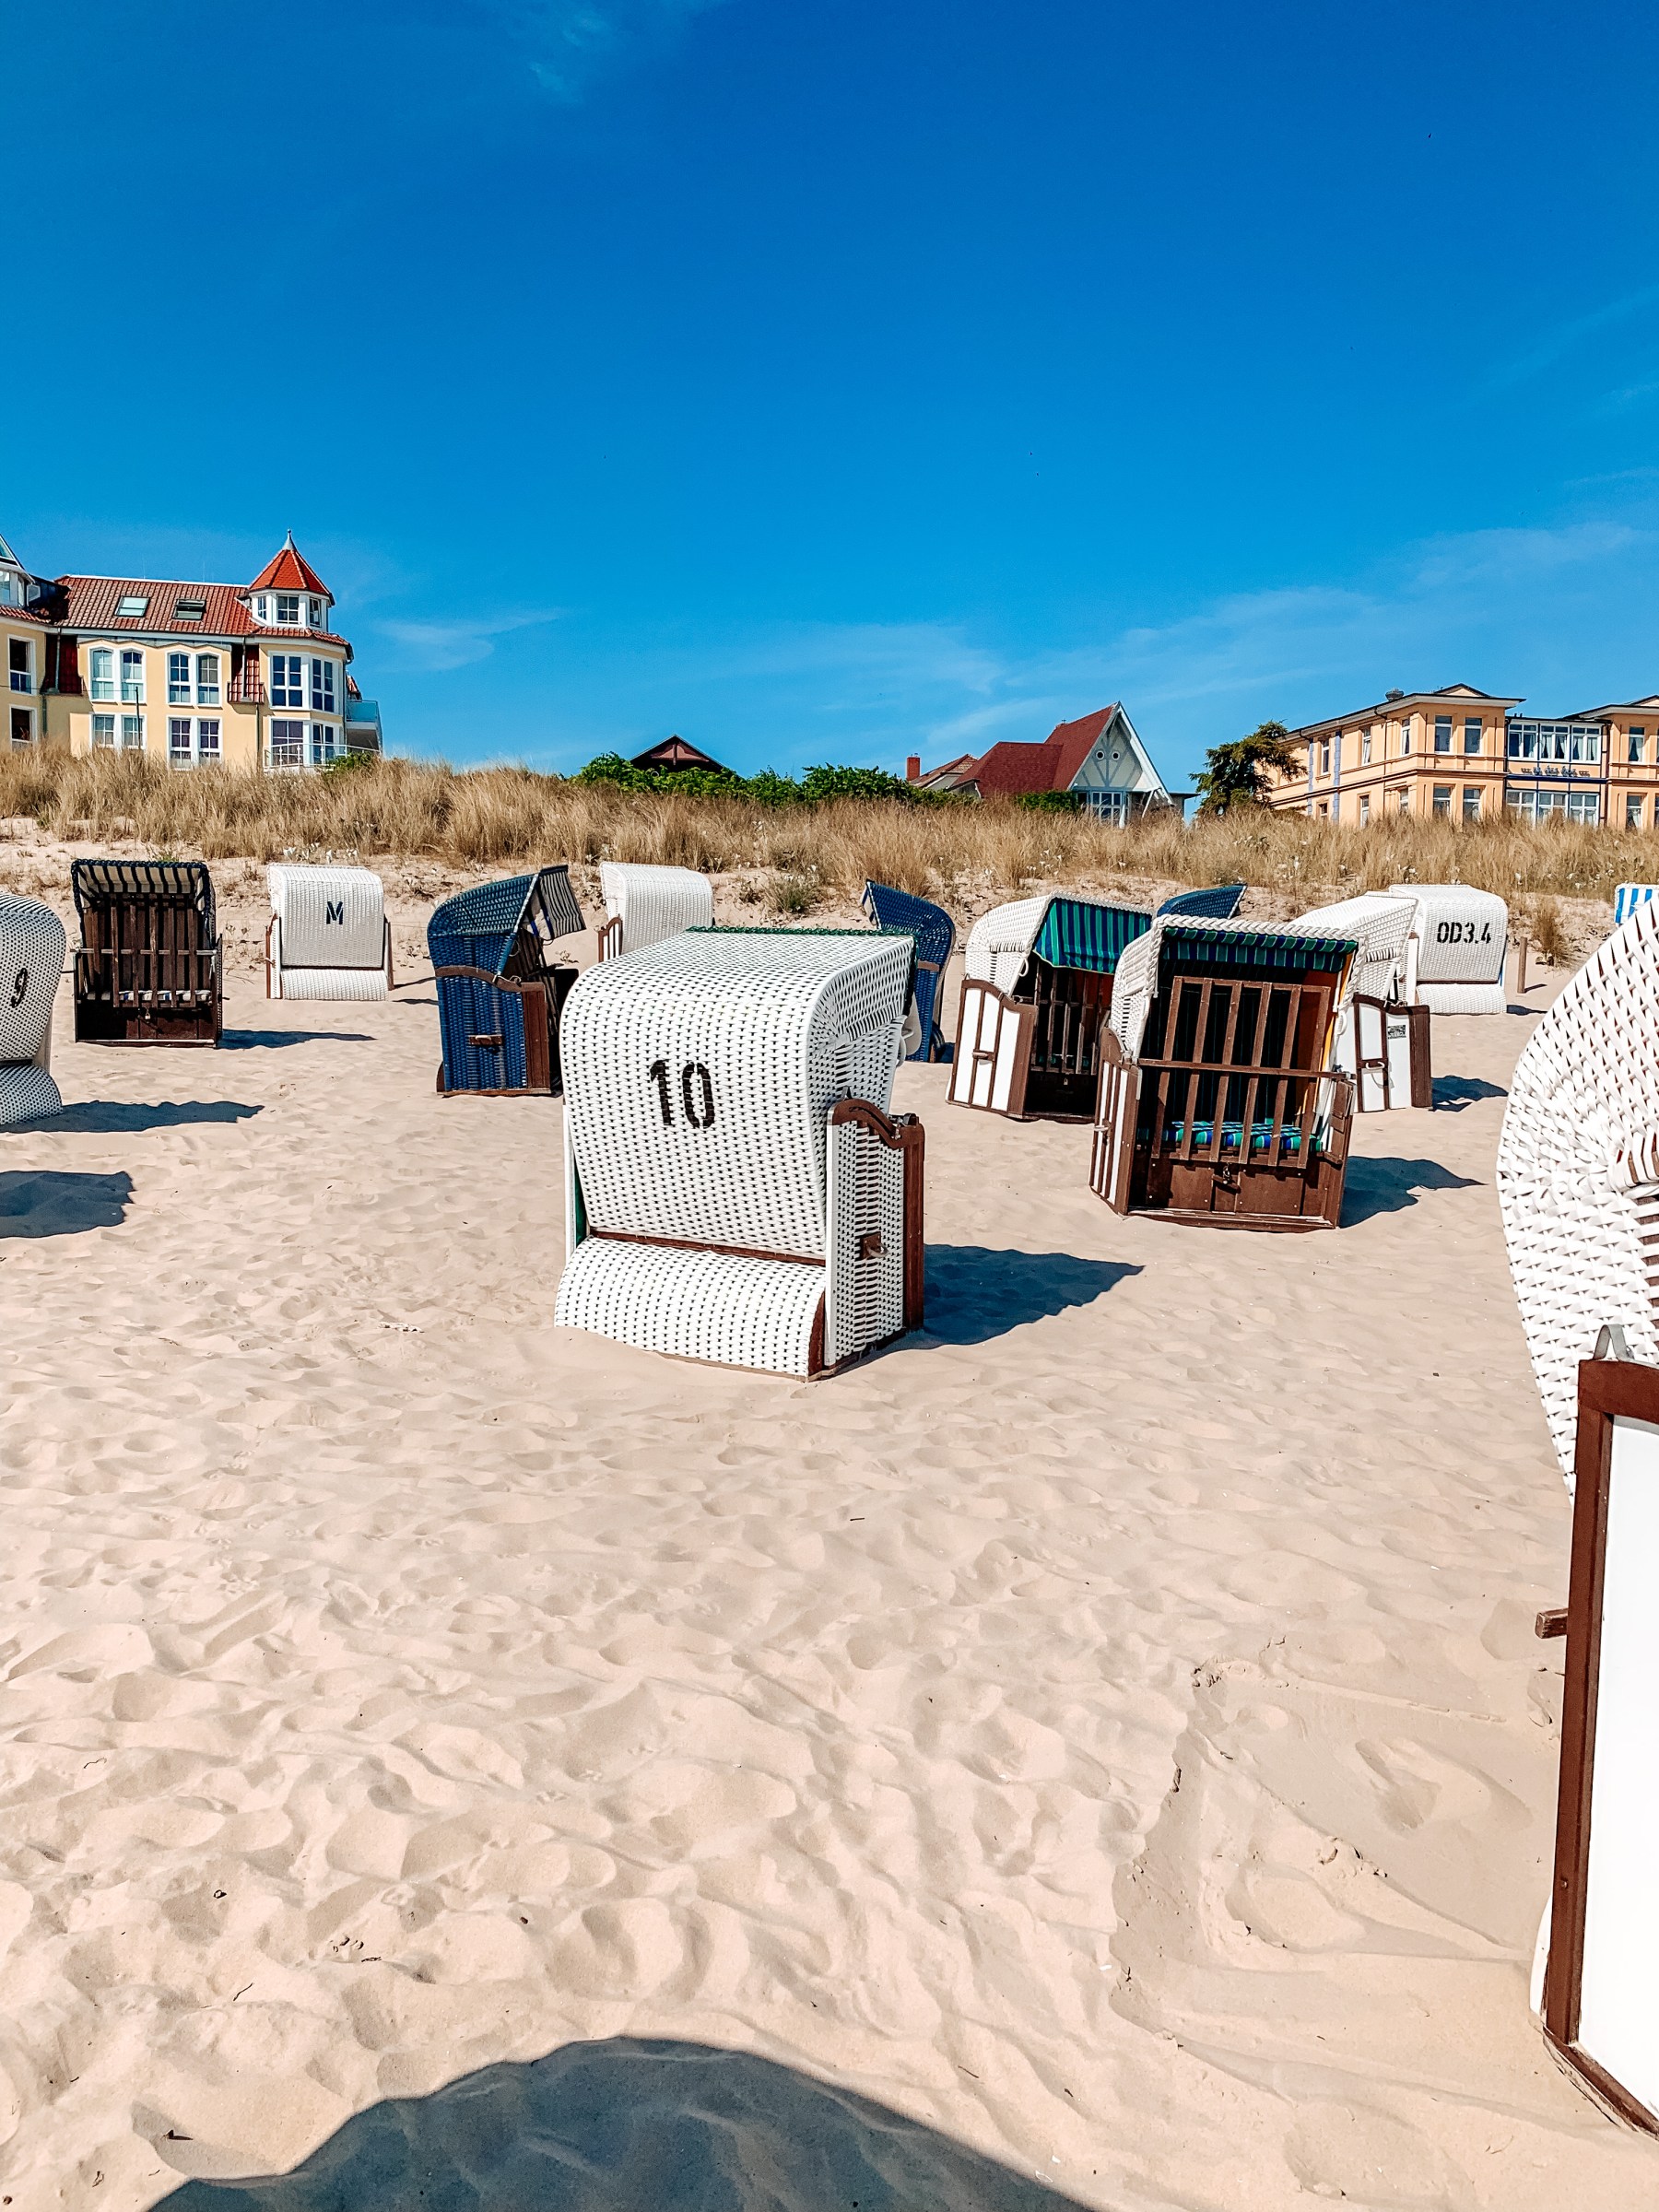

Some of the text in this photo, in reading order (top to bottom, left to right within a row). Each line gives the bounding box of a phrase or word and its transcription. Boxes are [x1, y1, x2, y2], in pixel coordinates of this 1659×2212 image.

[326, 901, 344, 924] M
[10, 967, 29, 1008] 9
[650, 1059, 715, 1129] 10
